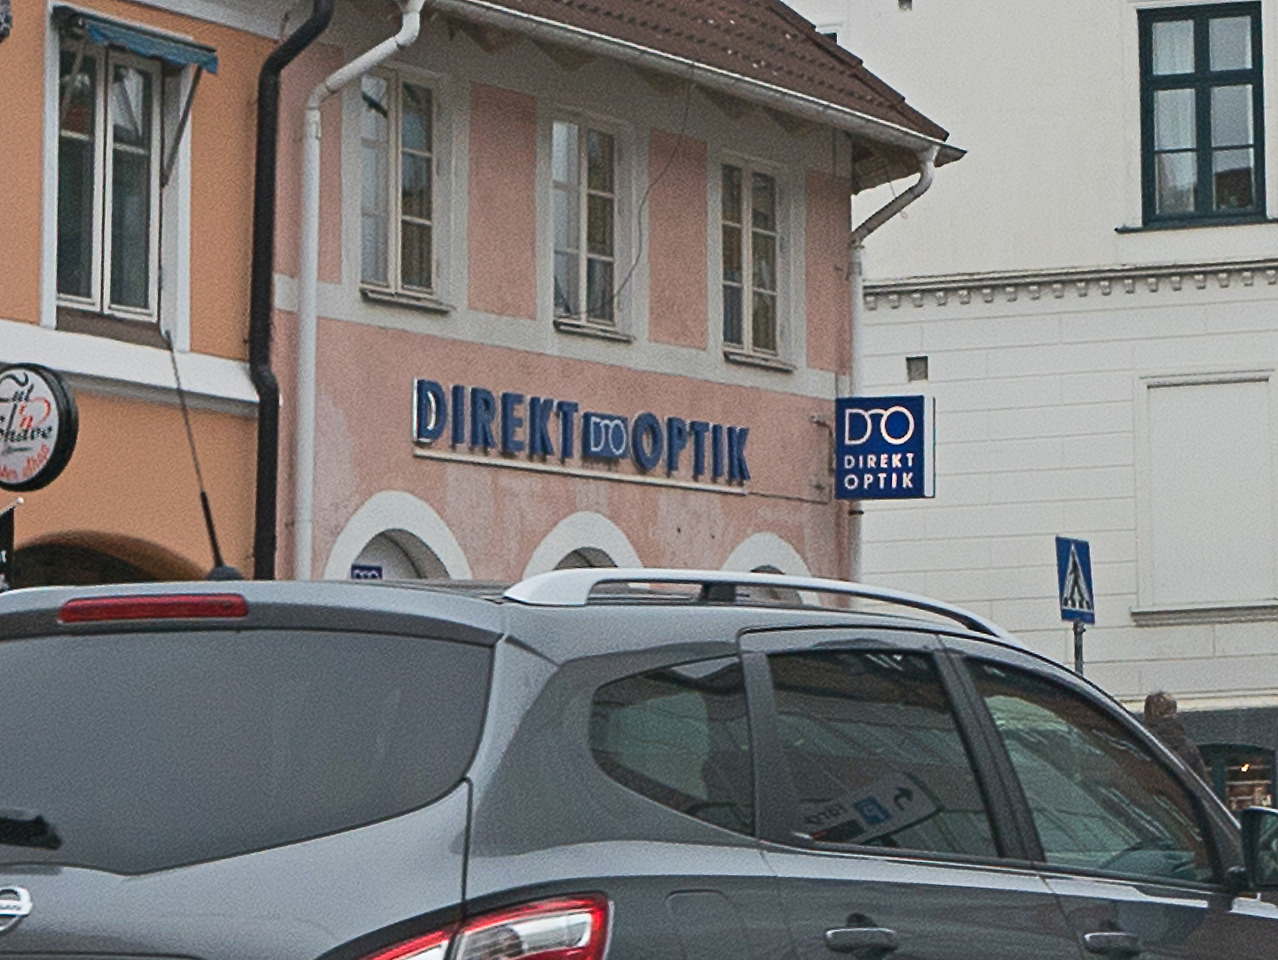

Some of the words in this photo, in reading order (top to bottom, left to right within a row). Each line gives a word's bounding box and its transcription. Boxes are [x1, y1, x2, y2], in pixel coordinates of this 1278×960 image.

[412, 377, 579, 460] DIREKT
[631, 410, 750, 482] OPTIK
[844, 452, 914, 469] DIREKT
[844, 471, 913, 490] OPTIK
